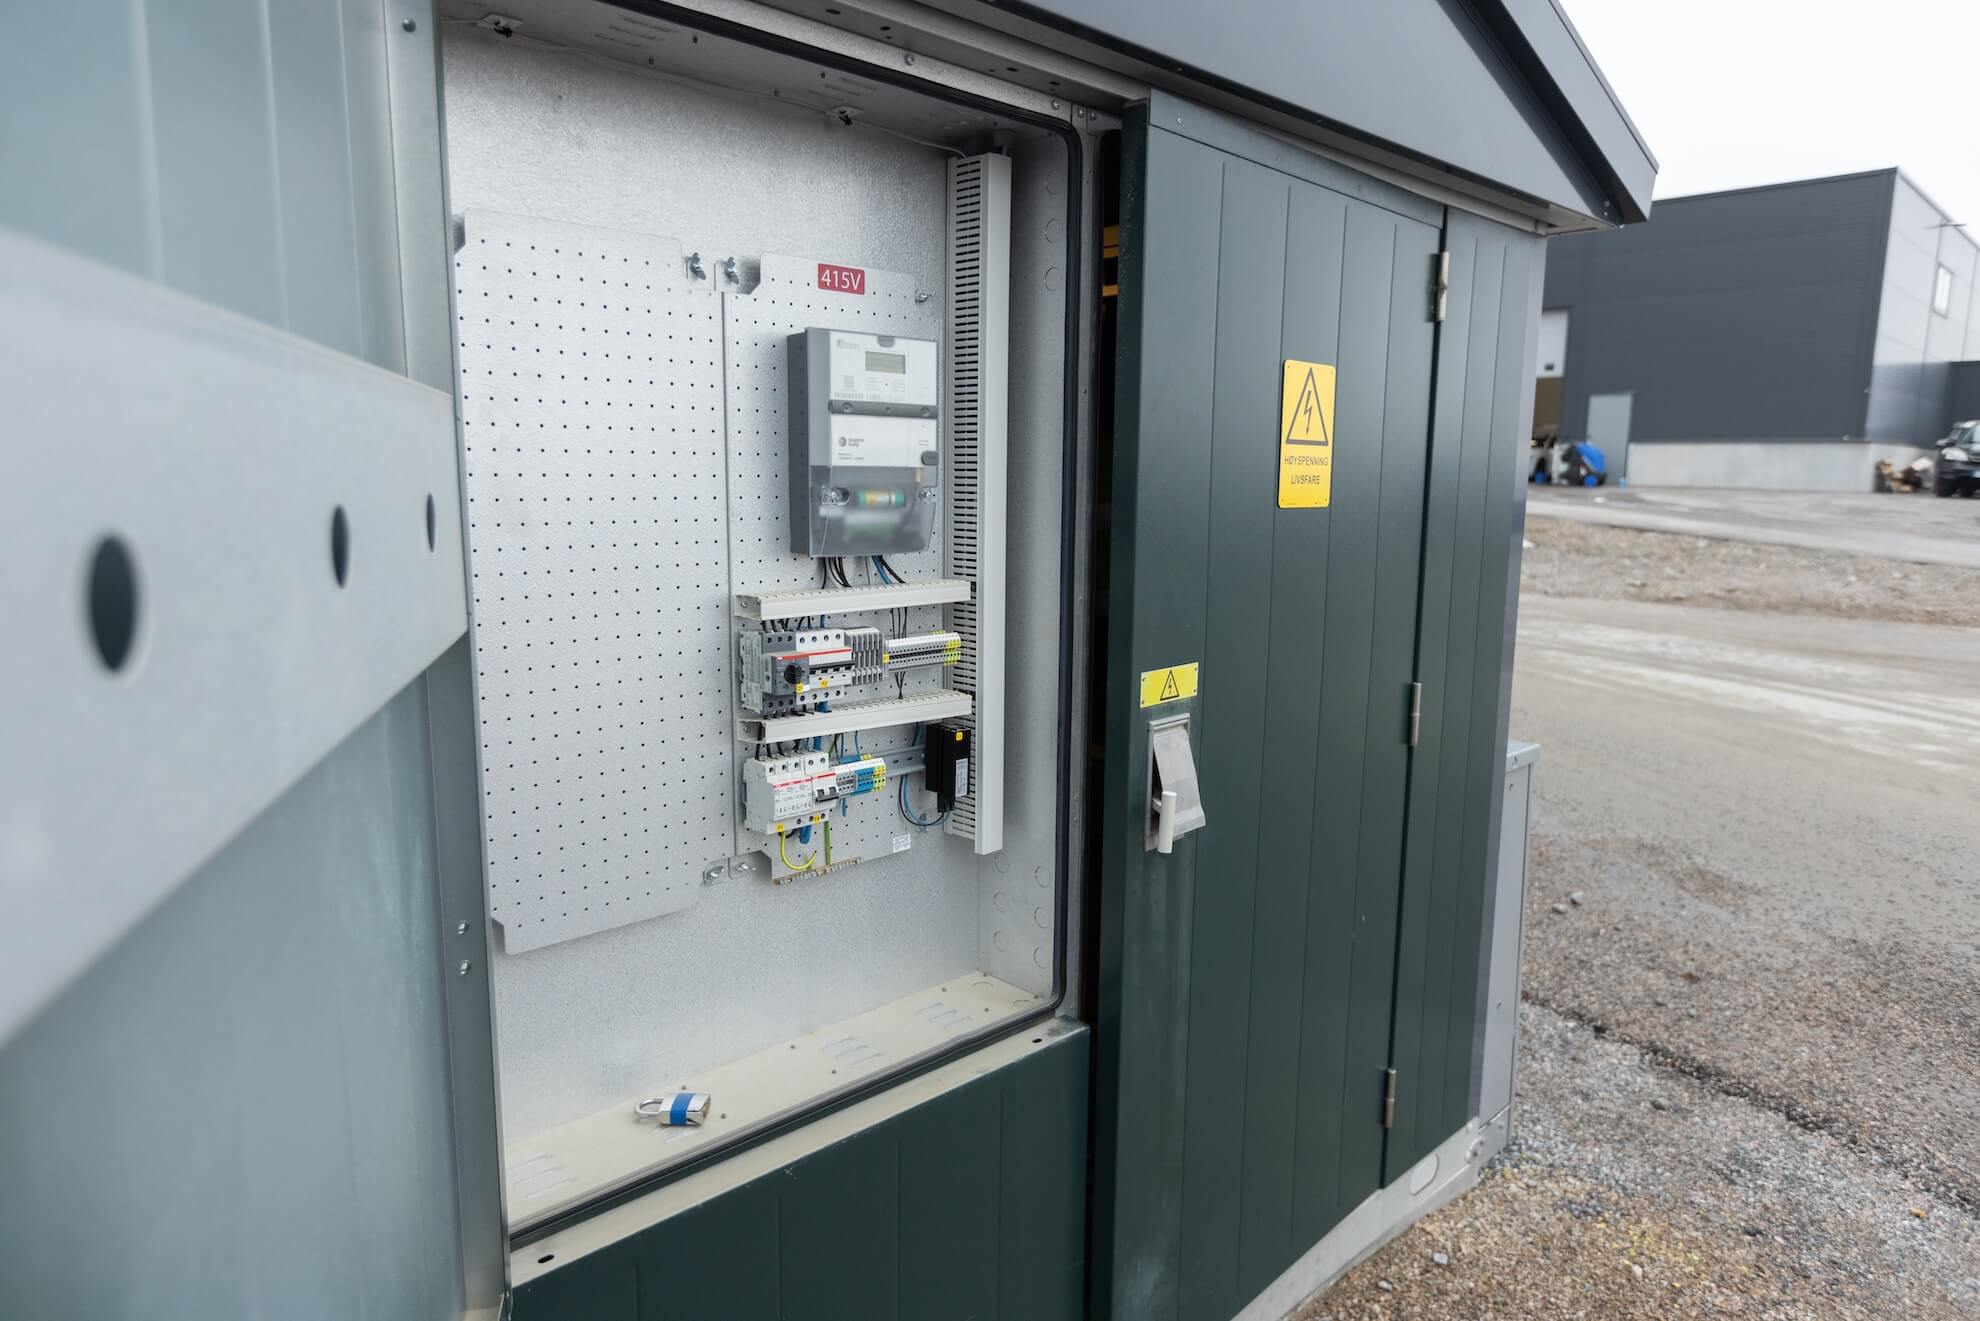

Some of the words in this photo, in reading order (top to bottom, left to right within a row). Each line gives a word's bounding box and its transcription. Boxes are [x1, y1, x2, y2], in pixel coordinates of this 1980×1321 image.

[821, 269, 861, 290] 415V
[1284, 456, 1329, 466] HØYSPENNING
[1291, 475, 1320, 485] LIVSFARE
